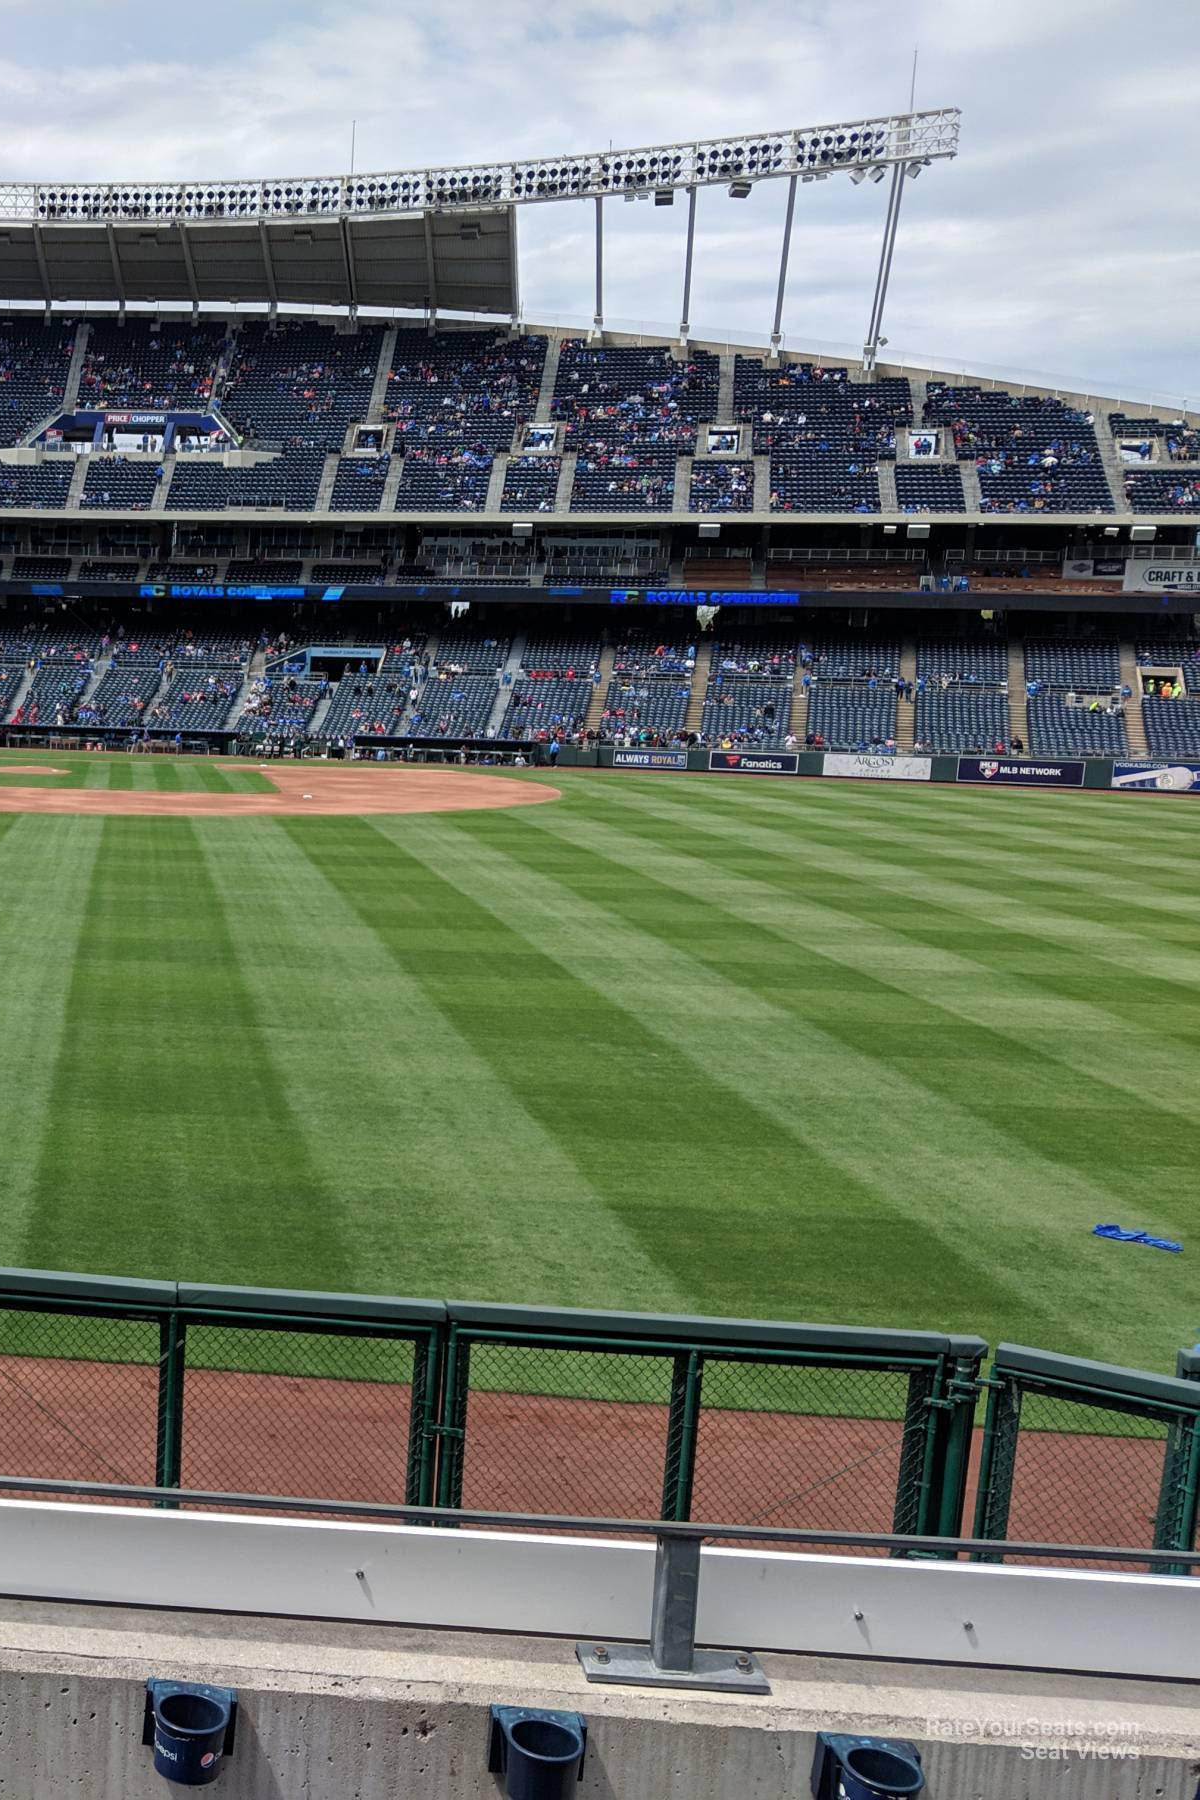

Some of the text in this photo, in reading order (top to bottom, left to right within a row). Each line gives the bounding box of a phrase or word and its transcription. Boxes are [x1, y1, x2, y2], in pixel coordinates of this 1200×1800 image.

[107, 415, 165, 423] PRICE CHOPPER
[1148, 571, 1184, 582] CRAFT
[1186, 571, 1194, 582] &
[171, 585, 224, 597] ROYALS
[646, 591, 706, 604] ROYALS
[615, 754, 649, 764] ALWAYS
[651, 755, 677, 765] ROYAL
[740, 758, 783, 769] Fanatics
[854, 755, 895, 767] ARGOSY
[1000, 766, 1062, 776] MLB NETWORK
